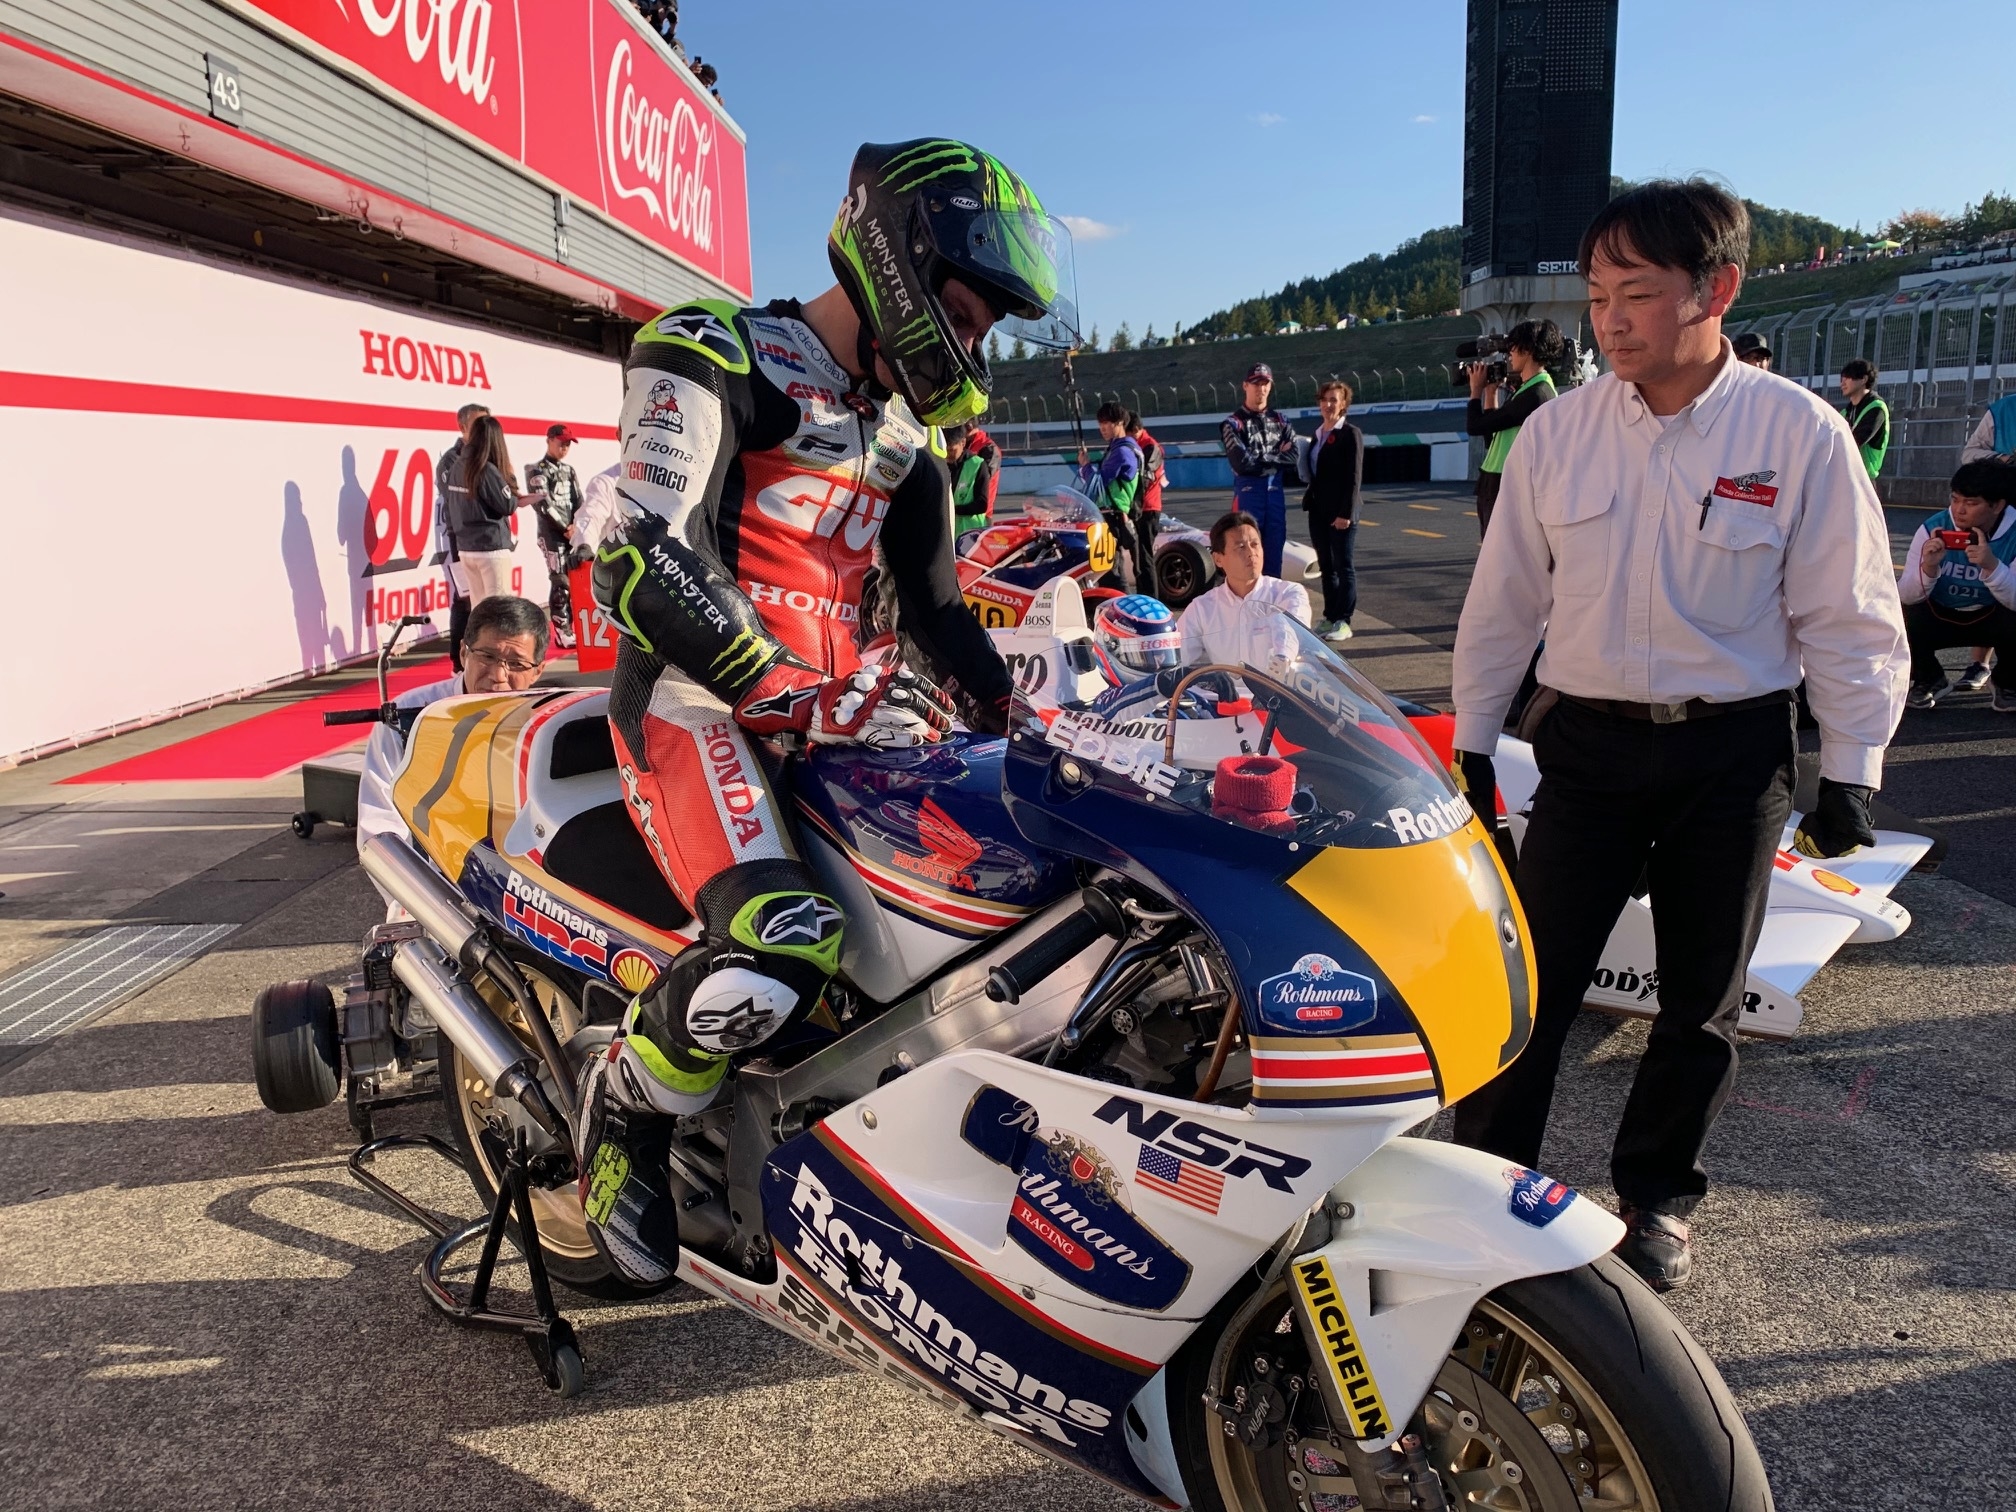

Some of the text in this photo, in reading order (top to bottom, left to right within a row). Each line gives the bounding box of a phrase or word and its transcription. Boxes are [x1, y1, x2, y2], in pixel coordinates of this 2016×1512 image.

[1504, 13, 1544, 46] 24
[212, 71, 242, 112] 43
[1503, 56, 1542, 89] 25
[606, 39, 714, 254] Coca-Cola
[557, 235, 569, 257] 44
[862, 240, 894, 308] ENERGY
[1537, 260, 1580, 274] SEIK
[359, 329, 492, 390] HONDA
[655, 408, 683, 425] CMS
[811, 413, 842, 432] COMET
[640, 437, 694, 464] rizoma
[362, 448, 434, 567] 60
[1734, 490, 1762, 501] Collection
[1093, 527, 1117, 567] 40
[1941, 560, 1980, 581] MED
[1948, 584, 1980, 598] 021
[365, 577, 450, 628] Honda
[649, 568, 706, 627] ENERGY
[969, 585, 1024, 609] HONDA
[1034, 600, 1051, 609] Senna
[578, 607, 611, 648] 12
[1024, 614, 1051, 626] BOSS
[1045, 714, 1181, 797] EDDIE
[702, 721, 764, 848] HONDA
[891, 850, 976, 891] HONDA
[505, 869, 608, 947] Rothmans
[502, 891, 608, 981] HRC
[712, 953, 729, 963] one
[1271, 979, 1365, 1006] Rothmans
[1305, 1007, 1333, 1019] RACING
[1091, 1096, 1313, 1195] NSR
[998, 1099, 1157, 1281] Rthmans
[1020, 1207, 1075, 1256] RACING
[791, 1161, 1112, 1430] Rothmans
[1299, 1259, 1389, 1437] MICHELIN
